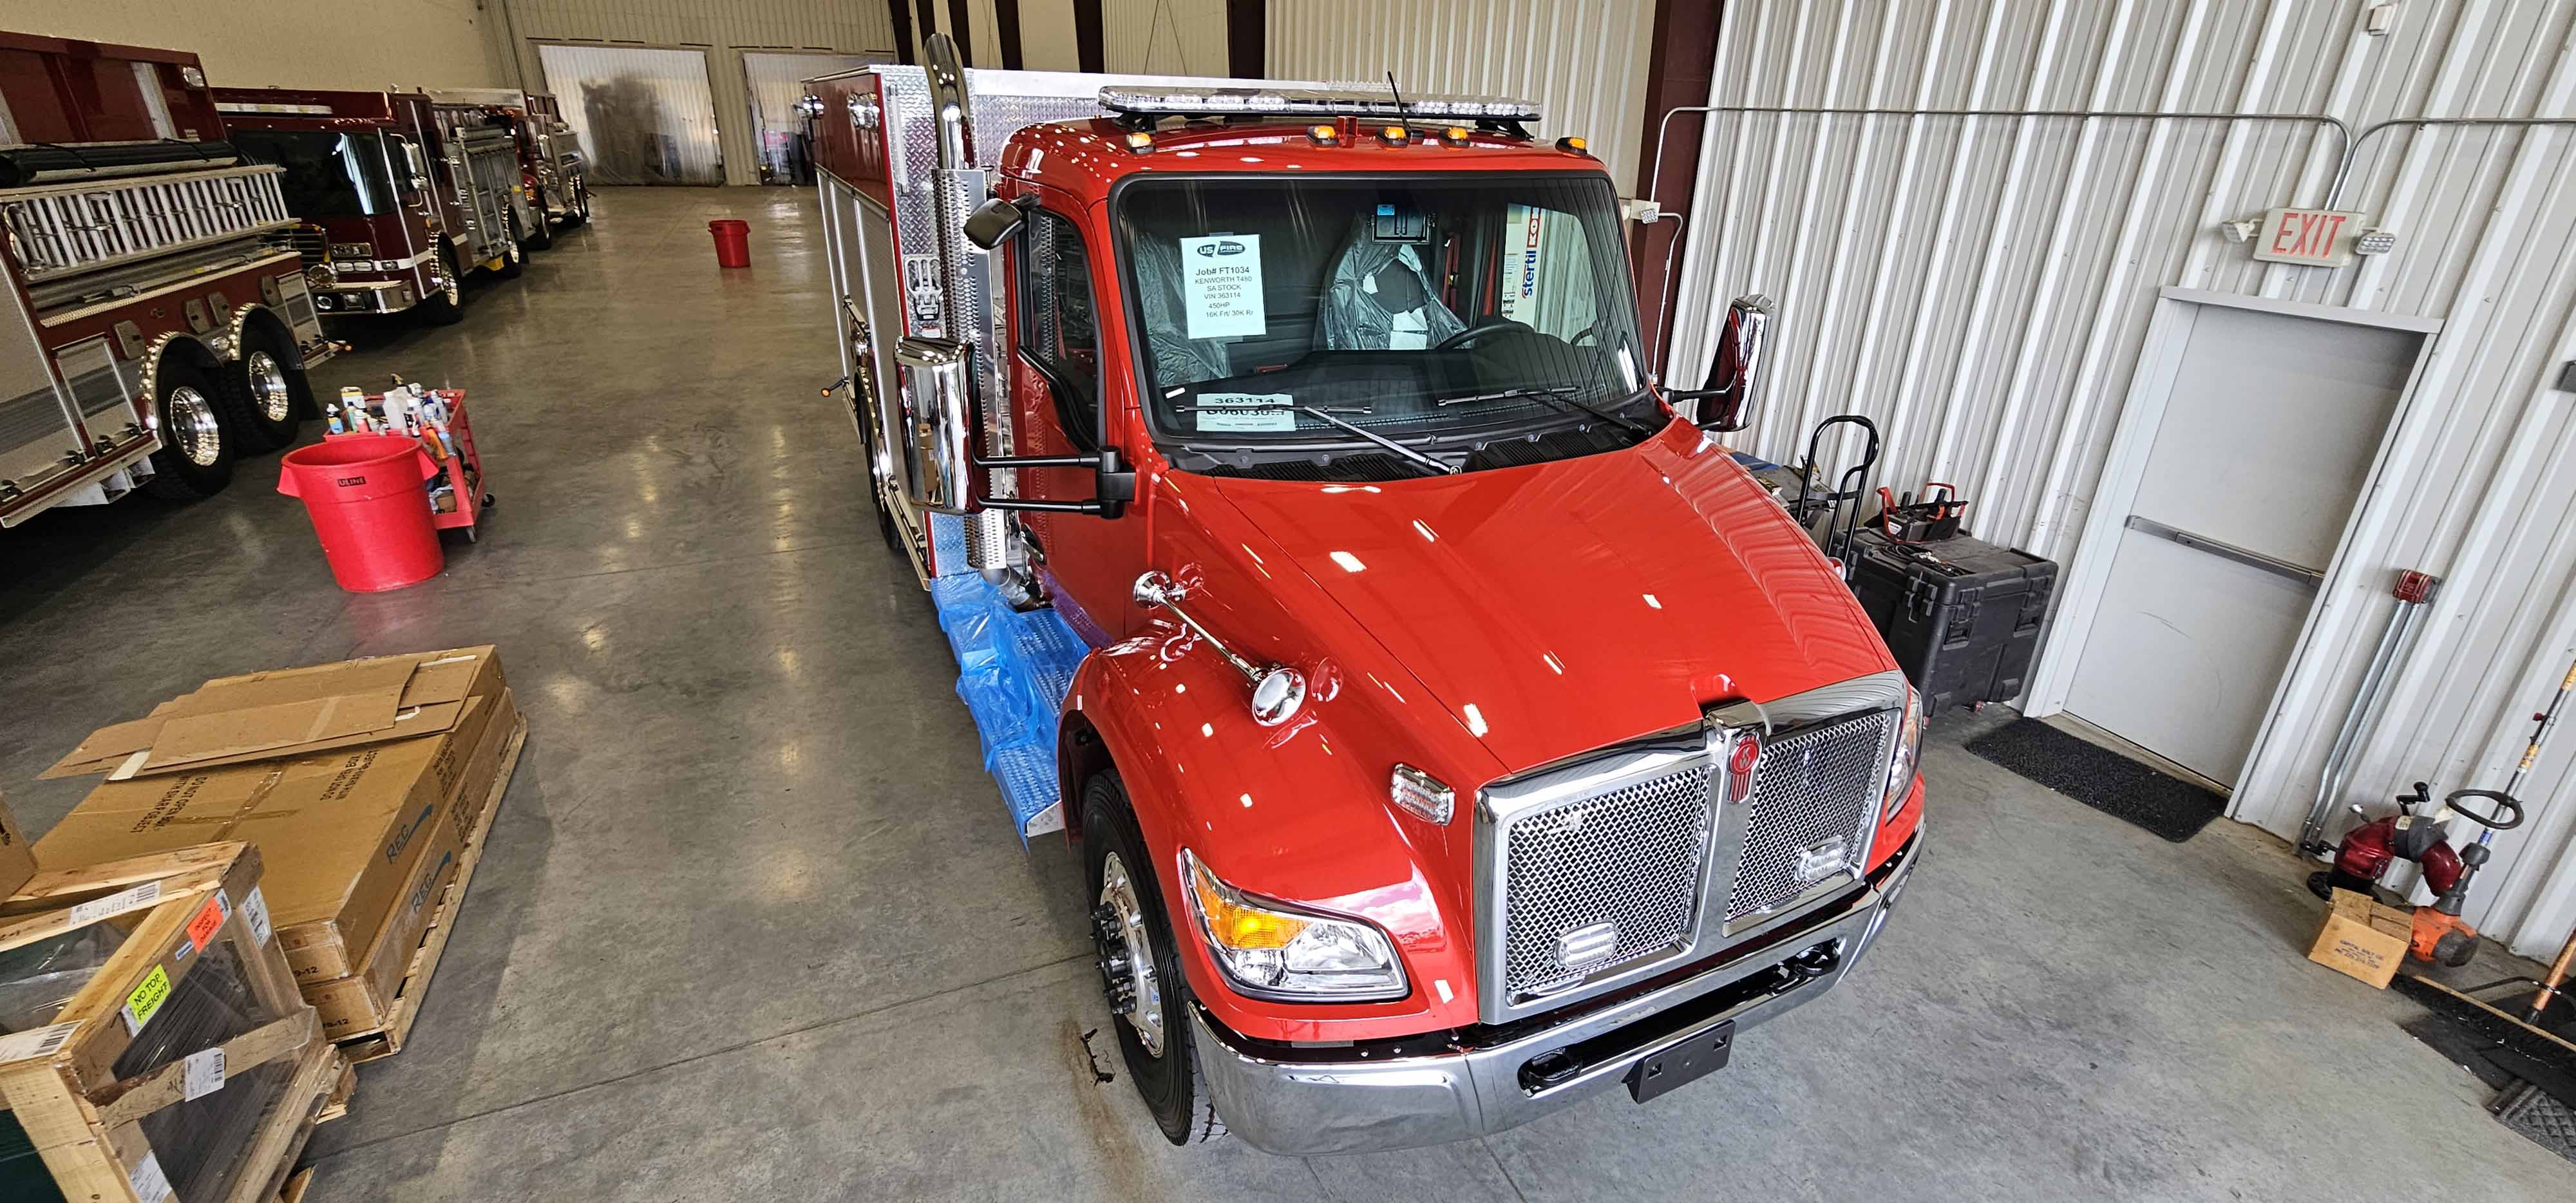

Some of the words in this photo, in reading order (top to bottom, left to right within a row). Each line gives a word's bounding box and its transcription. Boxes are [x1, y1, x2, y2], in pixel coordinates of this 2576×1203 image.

[1200, 246, 1213, 254] US
[2271, 213, 2346, 258] EXIT
[1195, 267, 1217, 276] Job#
[1219, 266, 1250, 274] FT1034
[1522, 250, 1537, 296] stertil
[339, 478, 365, 486] ULINE
[134, 990, 147, 1006] NO
[145, 973, 160, 992] TOP
[138, 981, 167, 1020] FREIGHT
